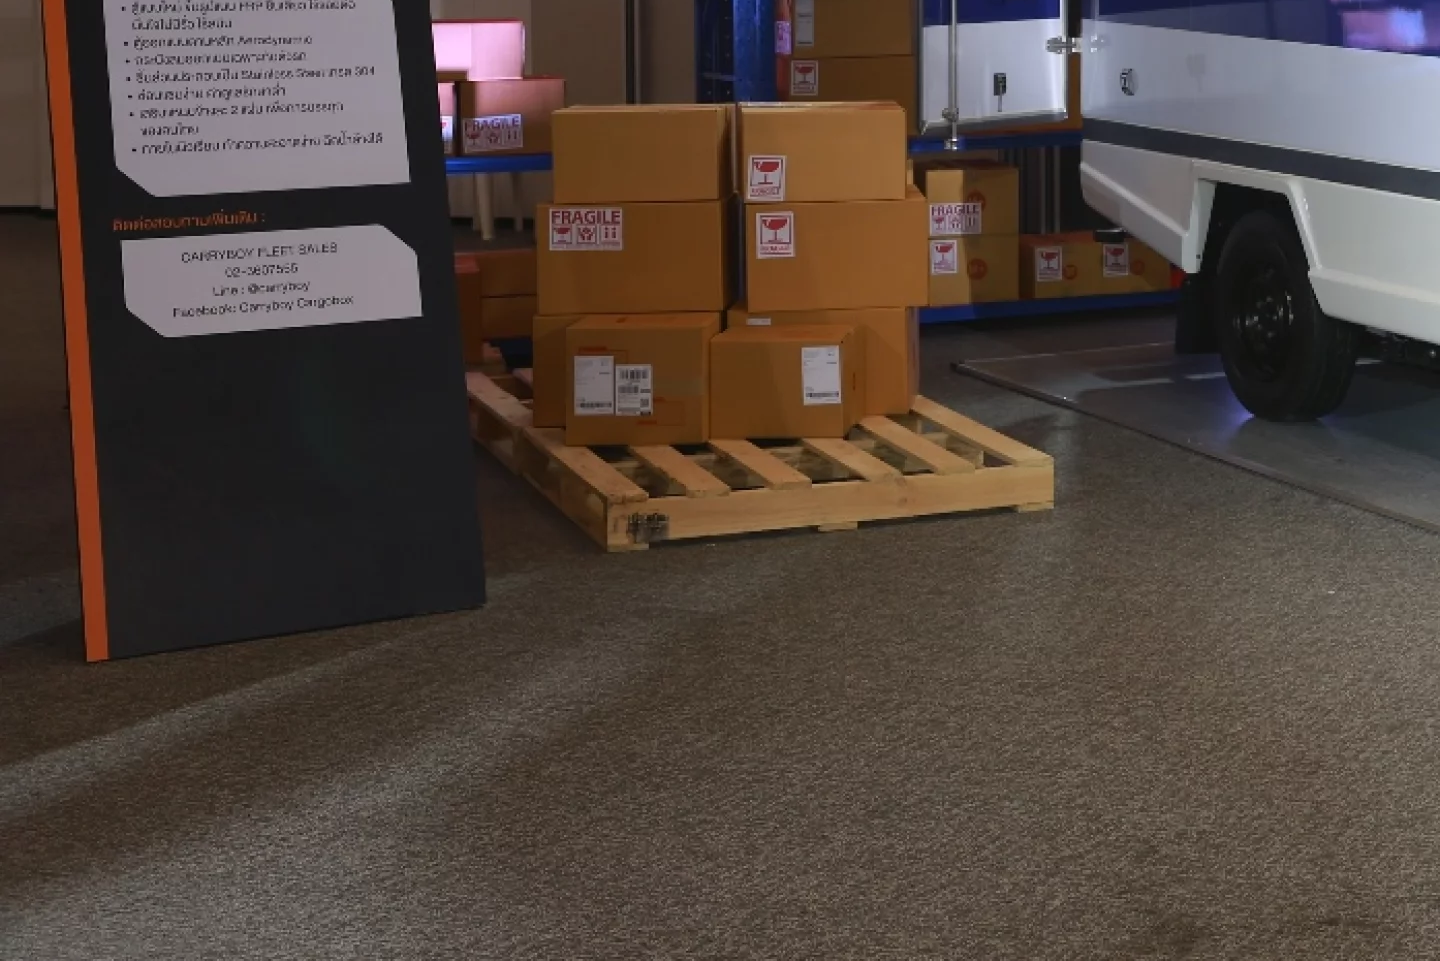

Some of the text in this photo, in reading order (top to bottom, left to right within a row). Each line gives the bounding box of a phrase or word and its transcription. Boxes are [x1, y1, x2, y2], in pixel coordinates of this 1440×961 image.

[931, 205, 981, 216] FRAGILE
[552, 211, 621, 224] FRAGILE
[181, 247, 254, 263] CARRYBOY
